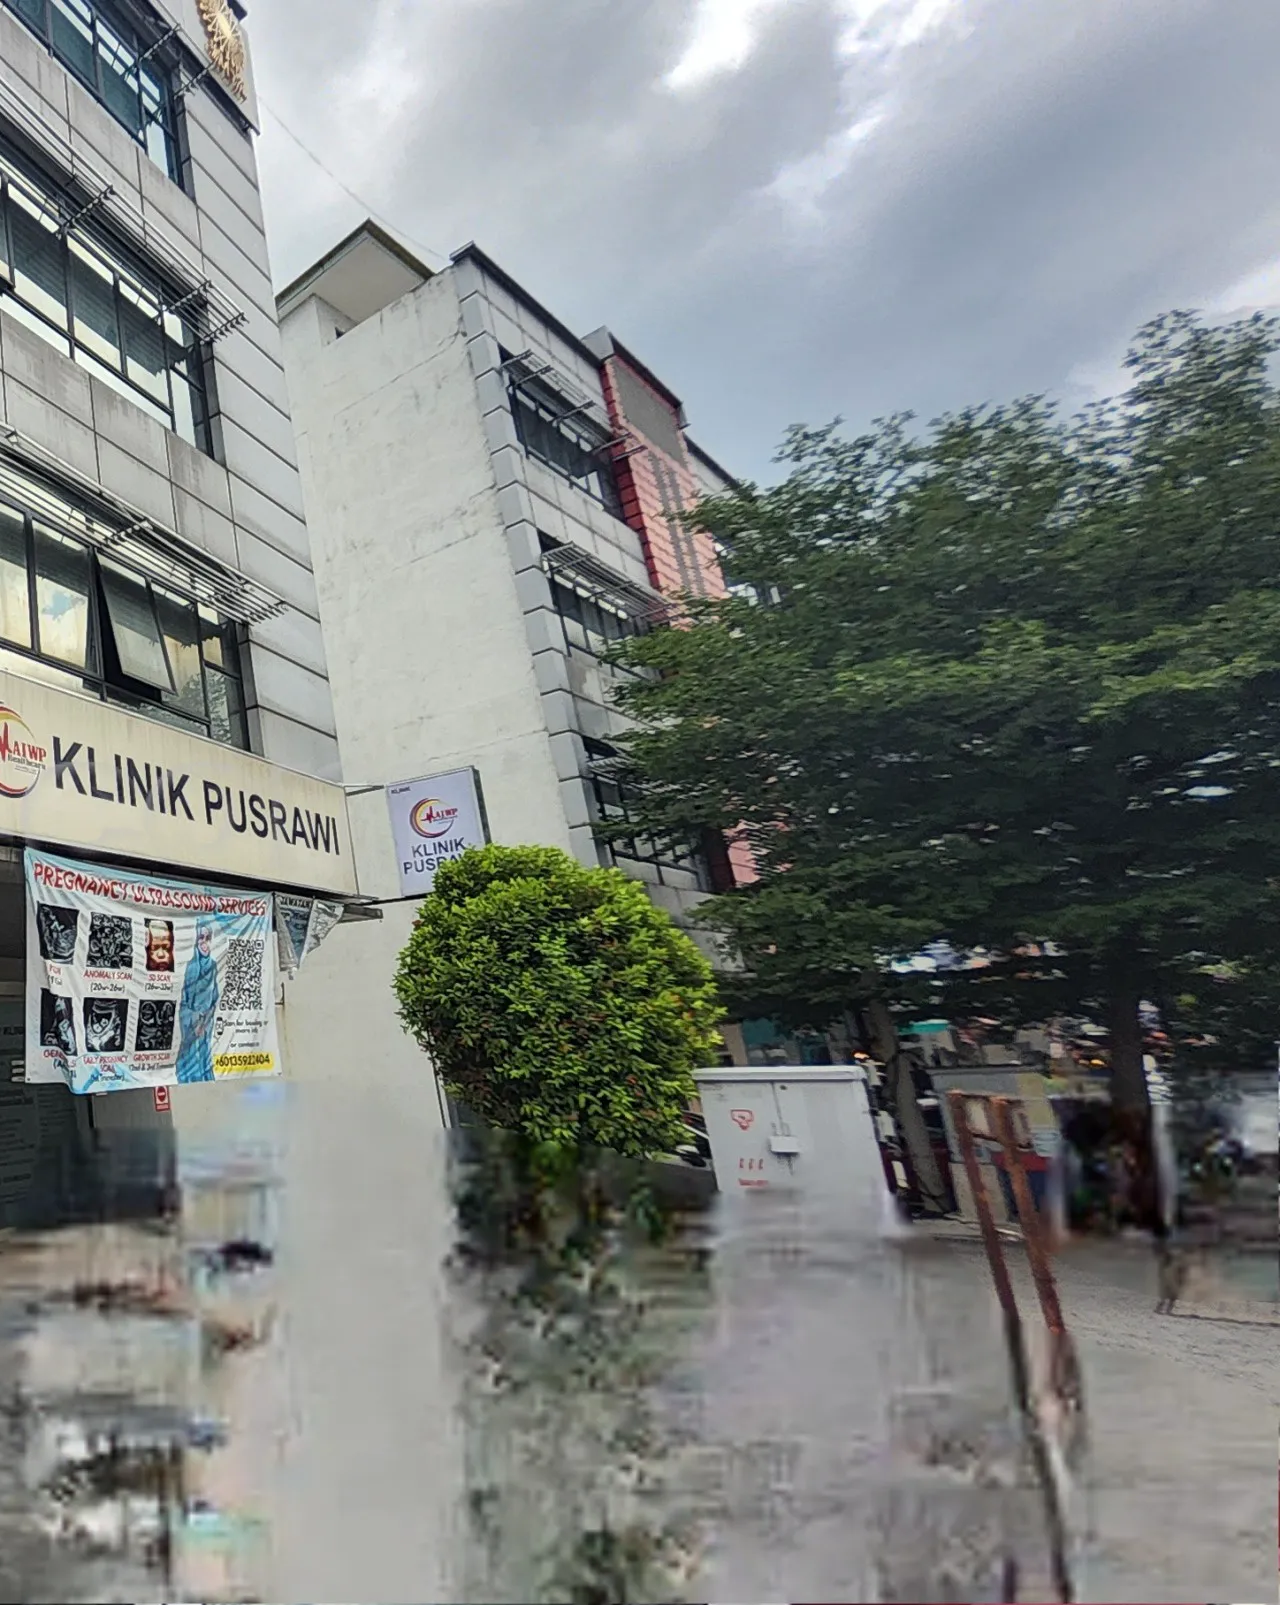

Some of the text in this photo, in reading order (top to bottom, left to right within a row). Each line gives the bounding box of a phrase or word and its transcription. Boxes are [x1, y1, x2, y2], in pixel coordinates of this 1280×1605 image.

[52, 735, 340, 856] KLINIK PUSRAWI
[412, 837, 466, 858] KLINIK
[33, 862, 268, 917] PREGNANCY ULTRASOUND SERVICES
[83, 969, 133, 981] ANOMALY SCAN
